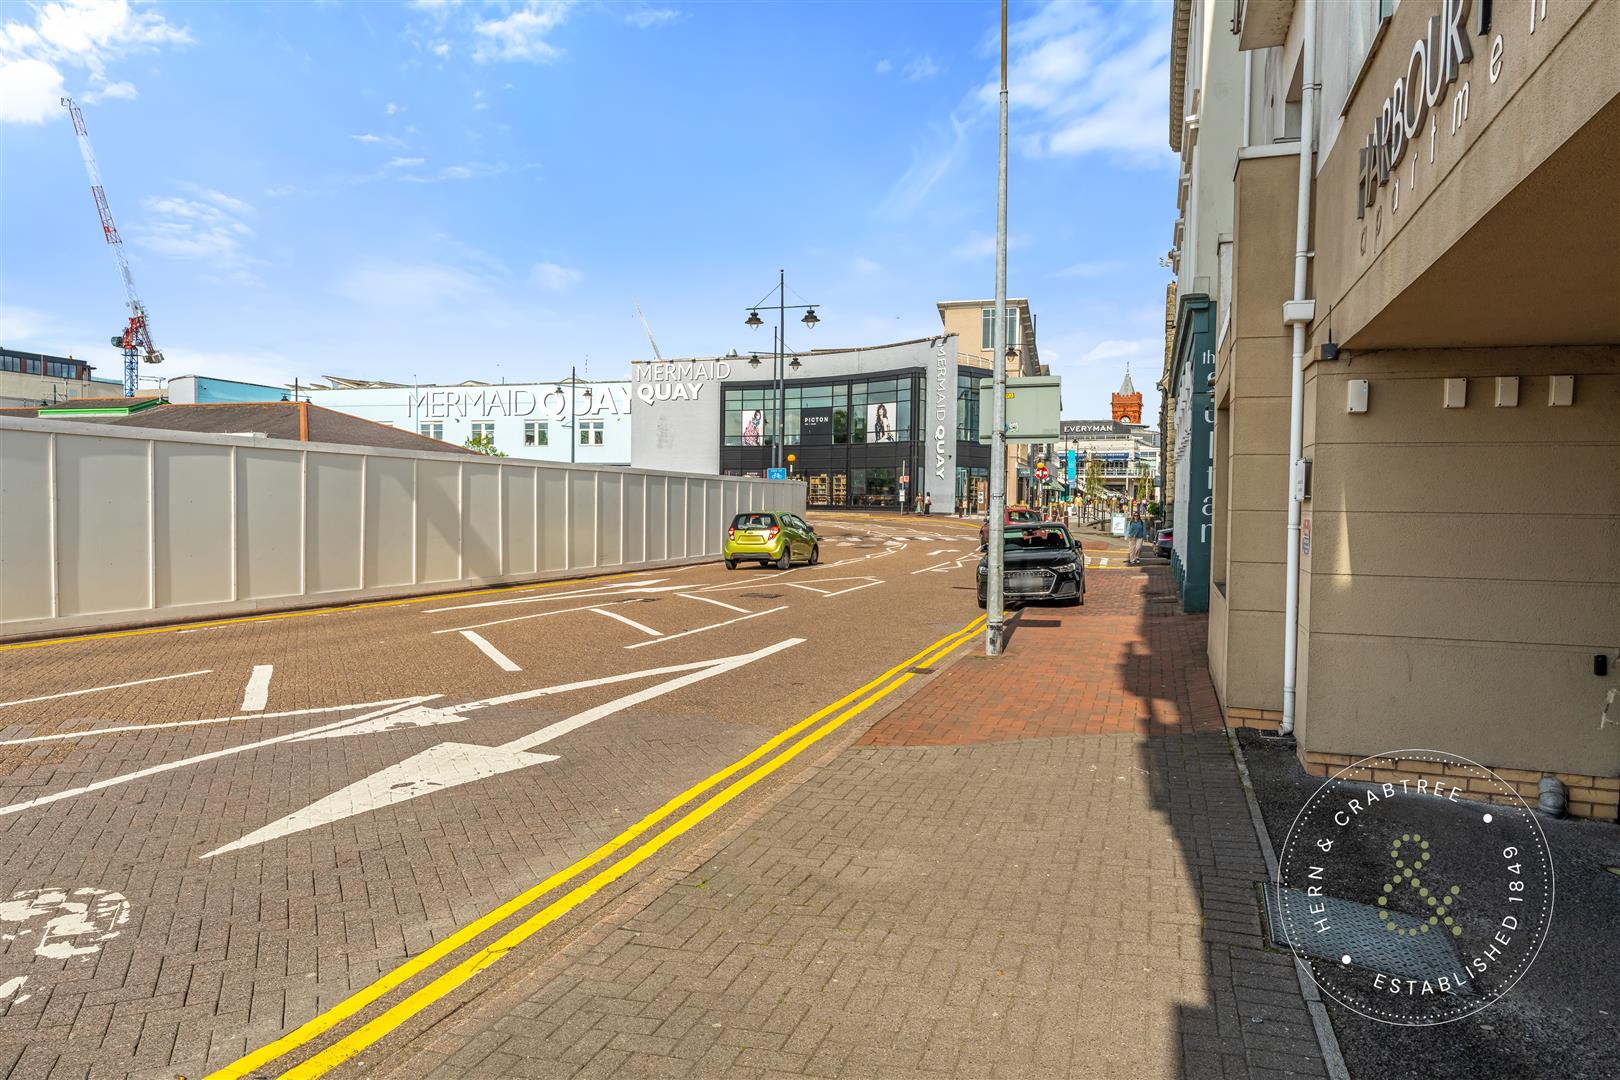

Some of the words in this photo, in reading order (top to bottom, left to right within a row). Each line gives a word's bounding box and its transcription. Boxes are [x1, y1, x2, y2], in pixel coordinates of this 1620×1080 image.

[1357, 0, 1474, 219] HARBOUR
[635, 362, 732, 383] MERMAID
[935, 342, 947, 421] MERMAID
[408, 388, 537, 418] MERMAID
[637, 383, 703, 406] QUAY
[1064, 424, 1113, 433] EVERYMAN
[935, 424, 945, 480] QUAY
